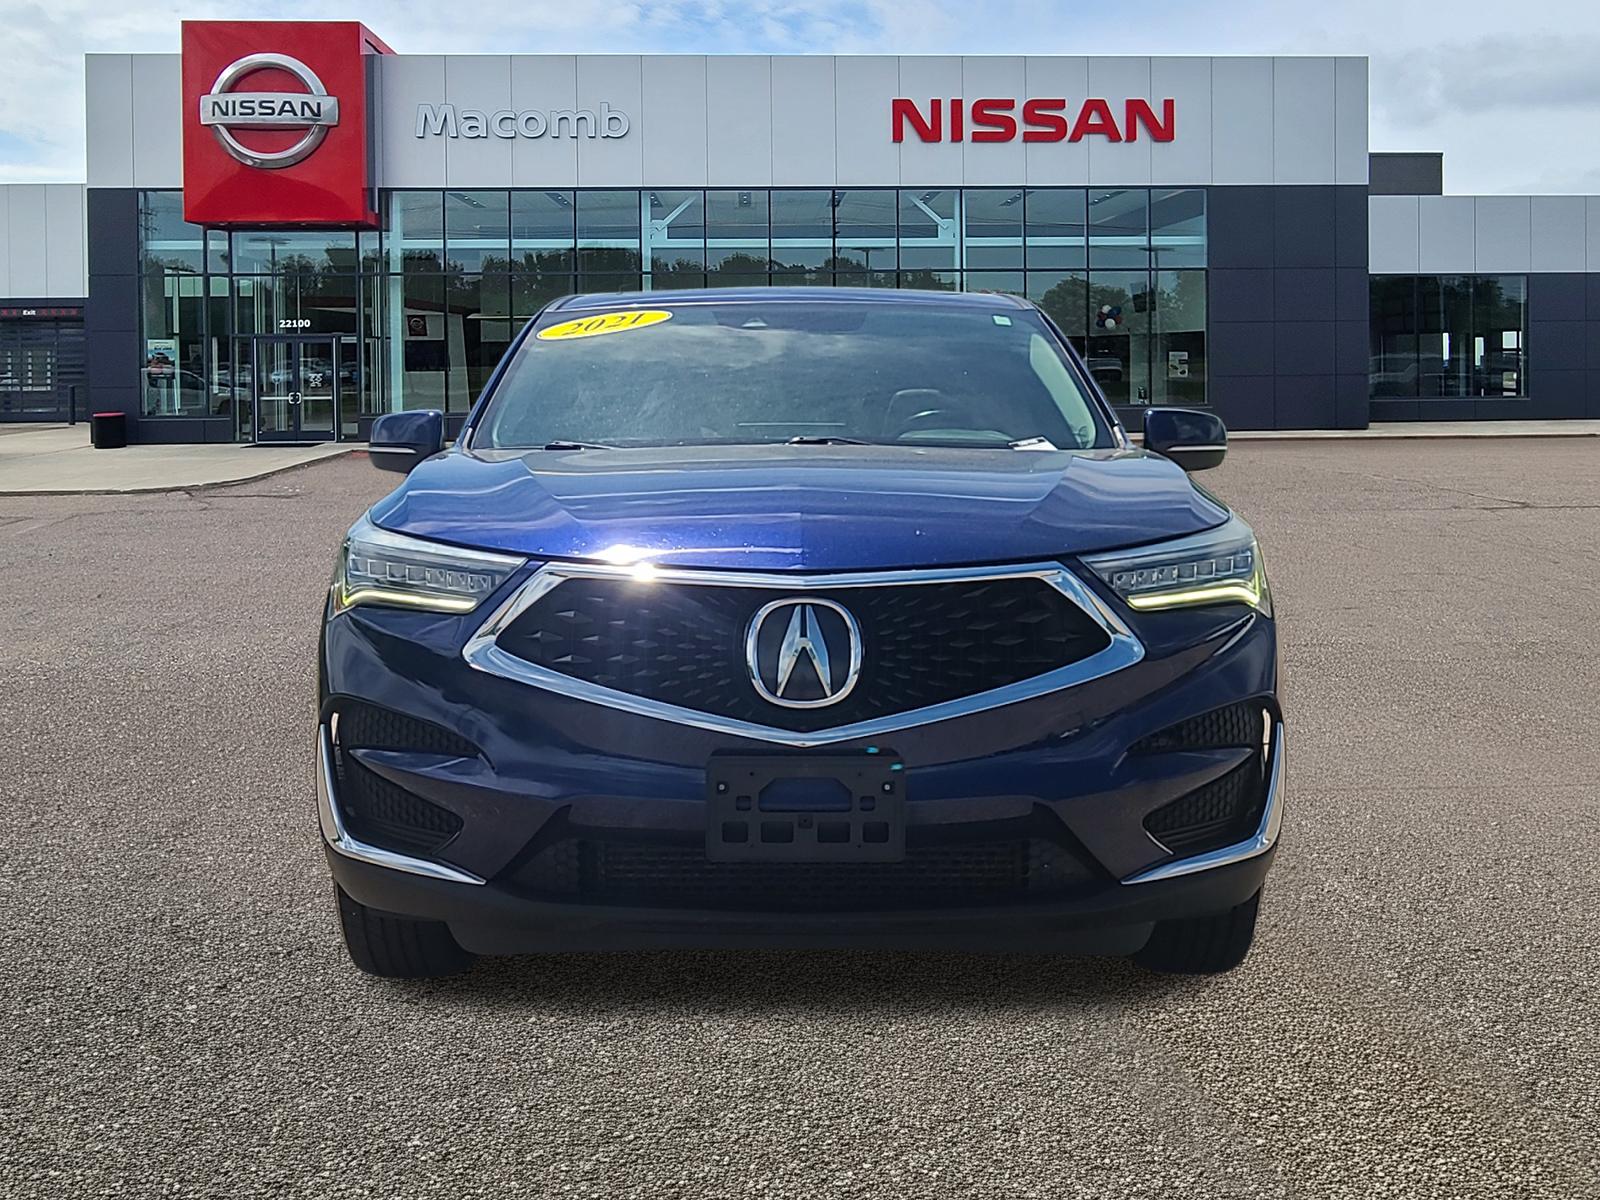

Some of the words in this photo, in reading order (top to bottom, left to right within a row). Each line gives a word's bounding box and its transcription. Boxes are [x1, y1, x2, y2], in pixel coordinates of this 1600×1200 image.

[212, 100, 322, 117] NISSAN
[415, 102, 630, 138] Macomb
[892, 98, 1175, 142] NISSAN
[279, 319, 311, 328] 22100
[561, 312, 646, 336] 2021
